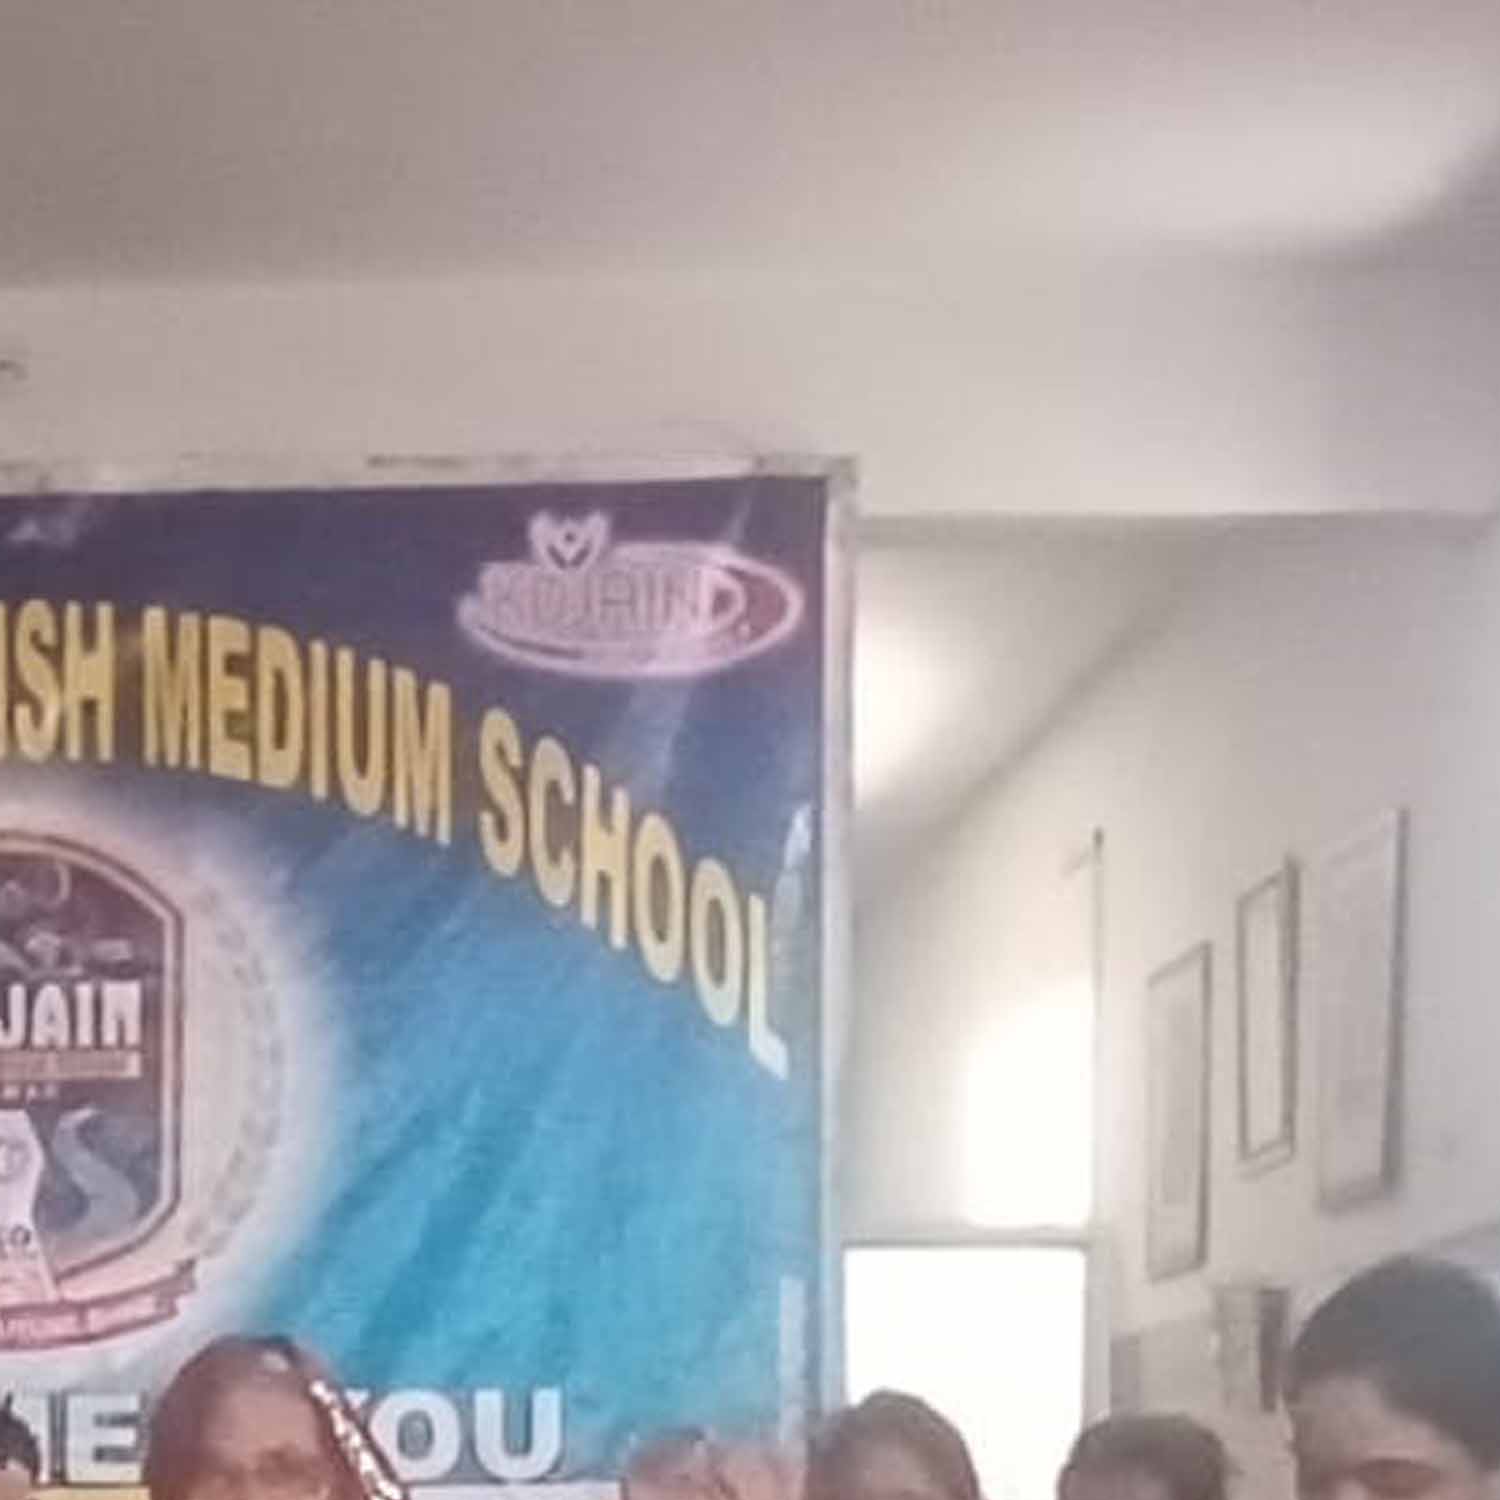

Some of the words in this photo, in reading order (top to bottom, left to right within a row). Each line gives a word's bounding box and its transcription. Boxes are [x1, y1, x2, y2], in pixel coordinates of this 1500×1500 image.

[143, 607, 452, 847] MEDIUM
[478, 707, 789, 1081] SCHOOL
[345, 1388, 564, 1482] OU
